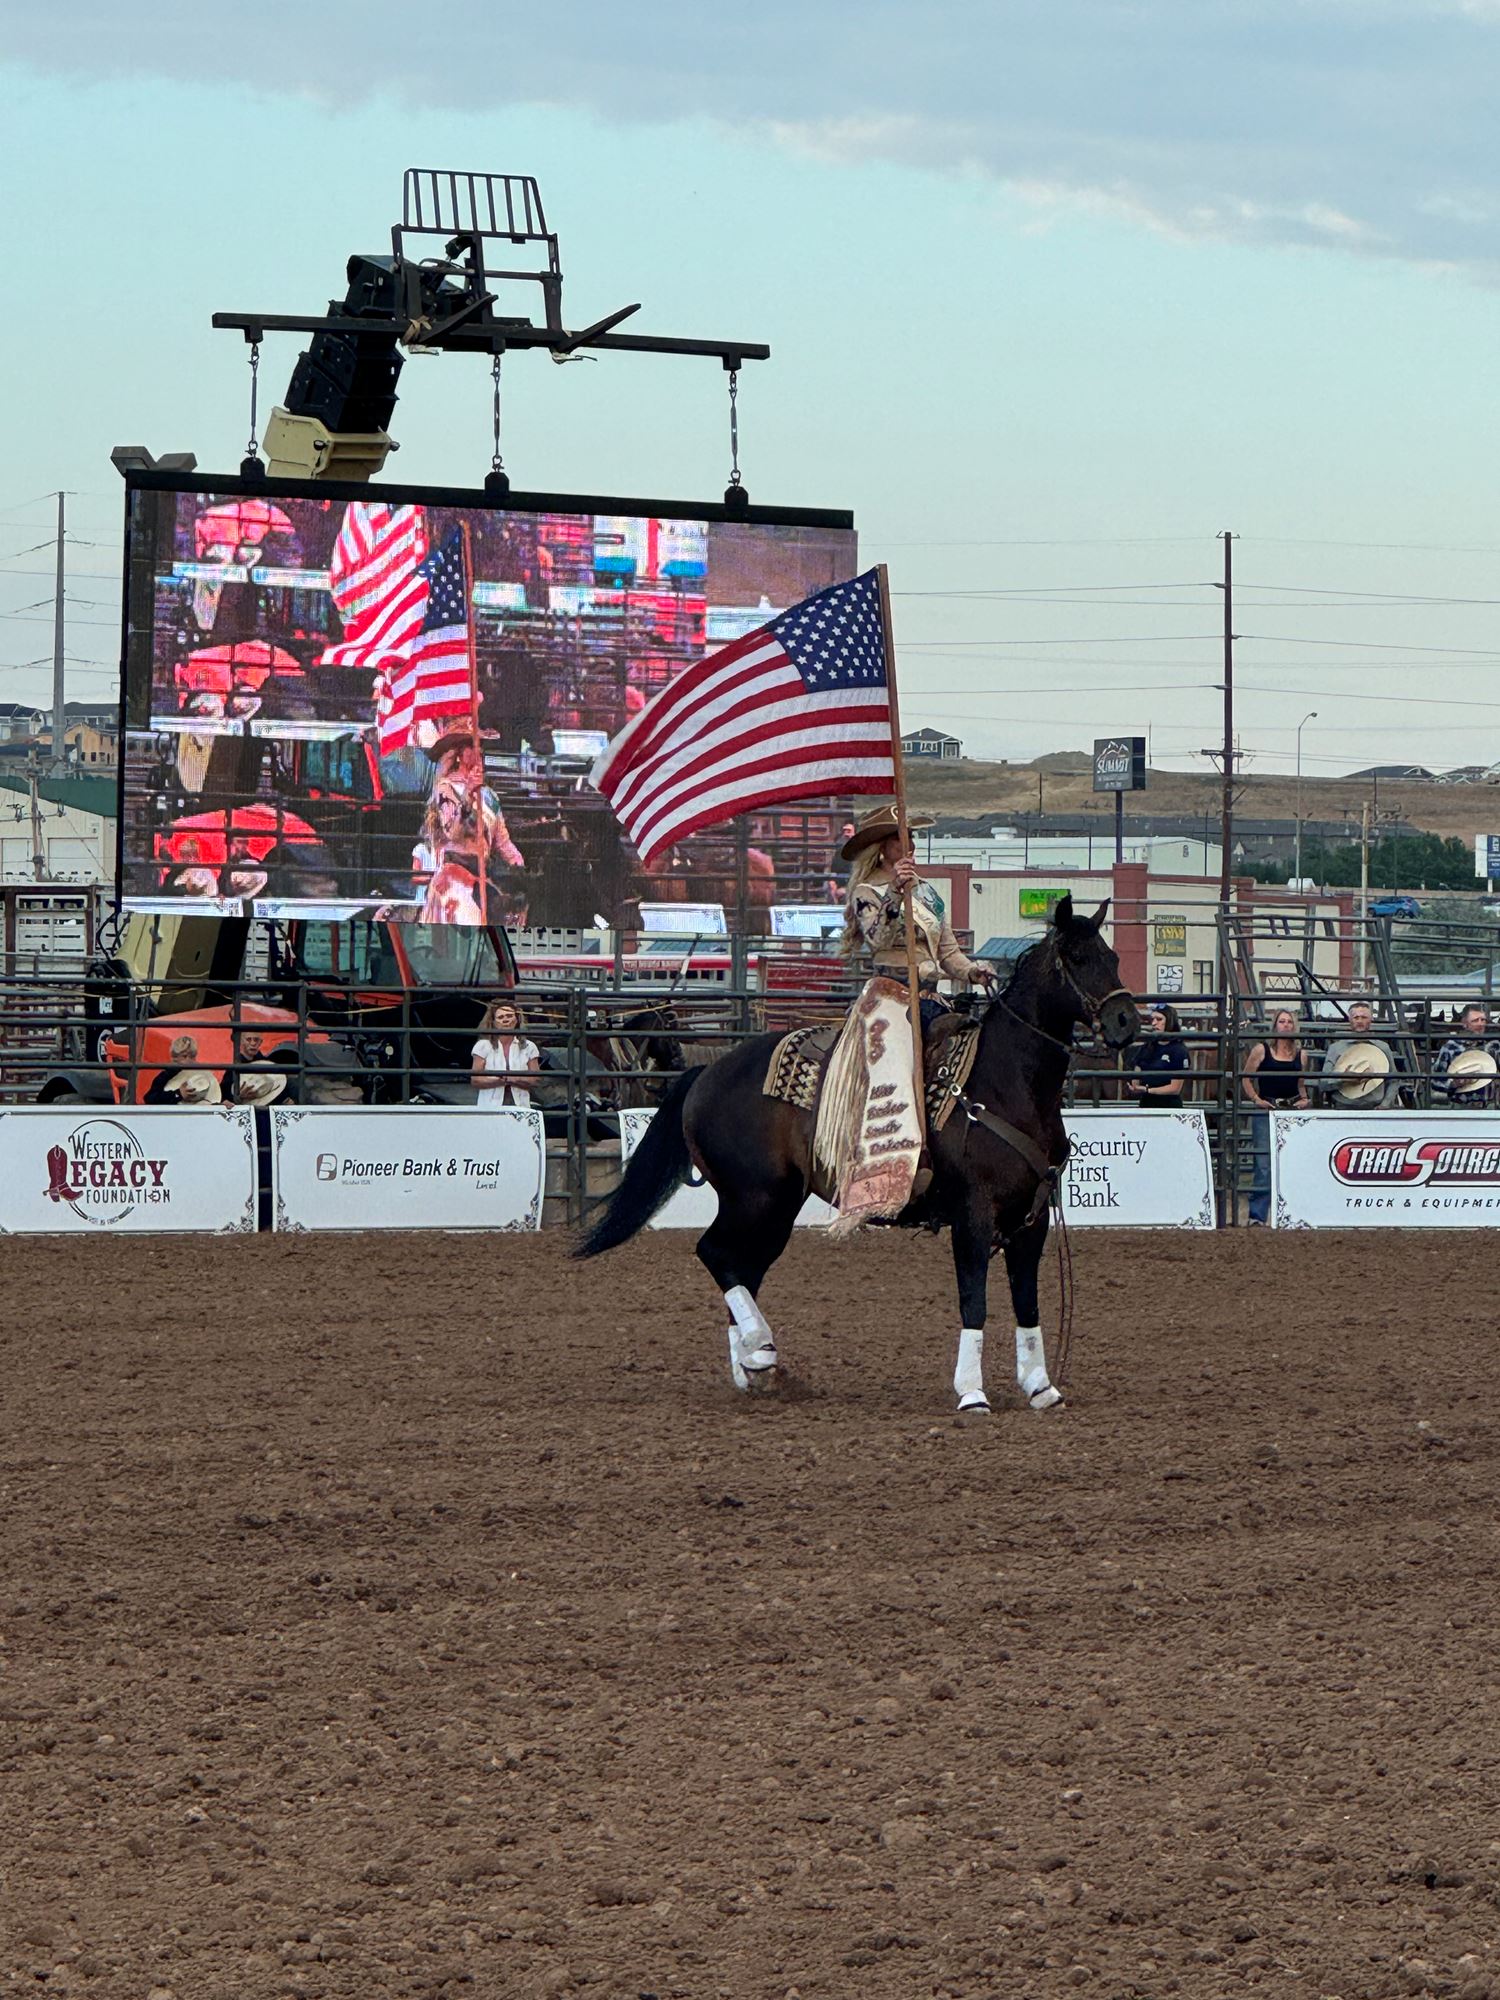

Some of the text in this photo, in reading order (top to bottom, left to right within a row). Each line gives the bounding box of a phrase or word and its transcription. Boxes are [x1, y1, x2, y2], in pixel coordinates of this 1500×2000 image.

[68, 1131, 132, 1160] WESTERN
[1067, 1132, 1147, 1164] Security
[342, 1158, 500, 1176] Pioneer Bank & Trust
[1066, 1158, 1109, 1182] First
[86, 1188, 171, 1204] FOUNDATION
[1067, 1182, 1120, 1208] Bank
[1346, 1198, 1395, 1208] TRUCK
[1403, 1199, 1412, 1208] &
